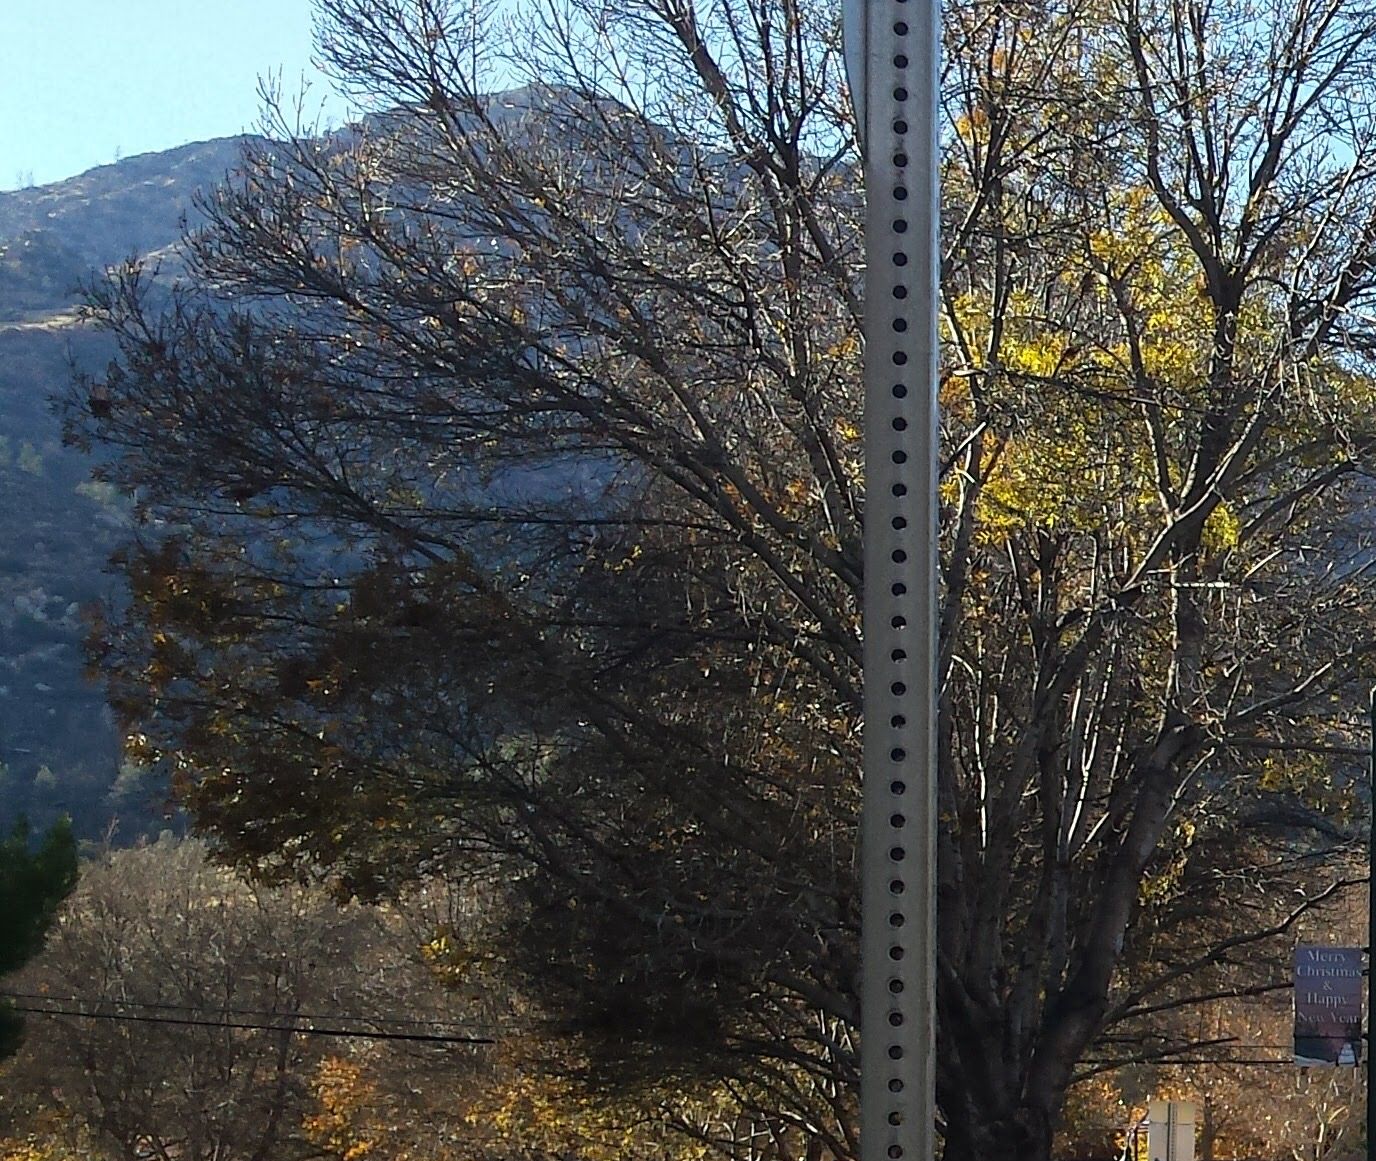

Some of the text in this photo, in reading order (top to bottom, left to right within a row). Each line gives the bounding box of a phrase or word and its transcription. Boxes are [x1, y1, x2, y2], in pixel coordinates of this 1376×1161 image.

[1308, 950, 1347, 963] Merry
[1297, 966, 1363, 978] Christmas
[1307, 992, 1347, 1008] Happy
[1299, 1011, 1361, 1024] New Year
